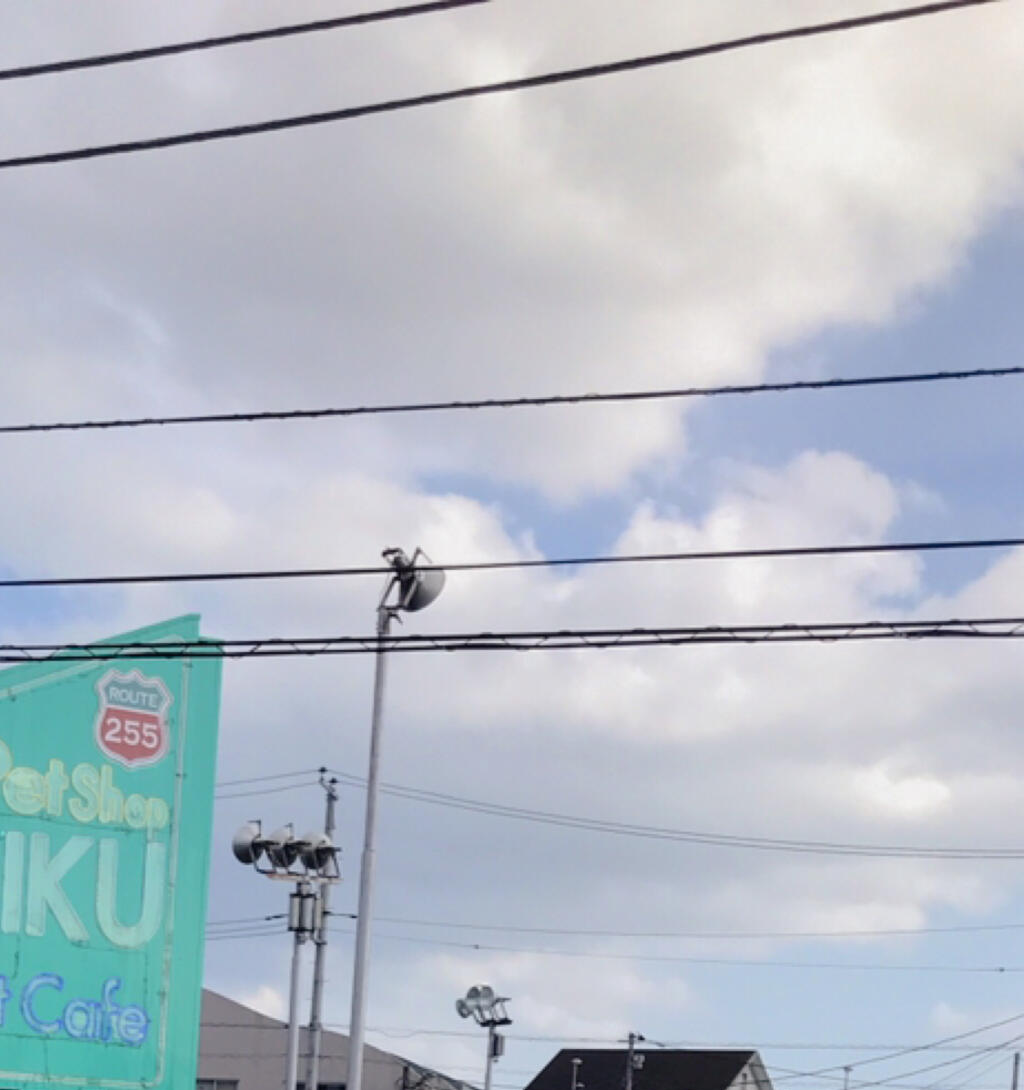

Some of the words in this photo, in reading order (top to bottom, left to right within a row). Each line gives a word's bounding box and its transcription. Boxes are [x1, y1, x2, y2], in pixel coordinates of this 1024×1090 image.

[108, 685, 160, 709] ROUTE
[103, 716, 160, 749] 255
[68, 763, 169, 838] Shop
[21, 972, 150, 1046] Cafe
